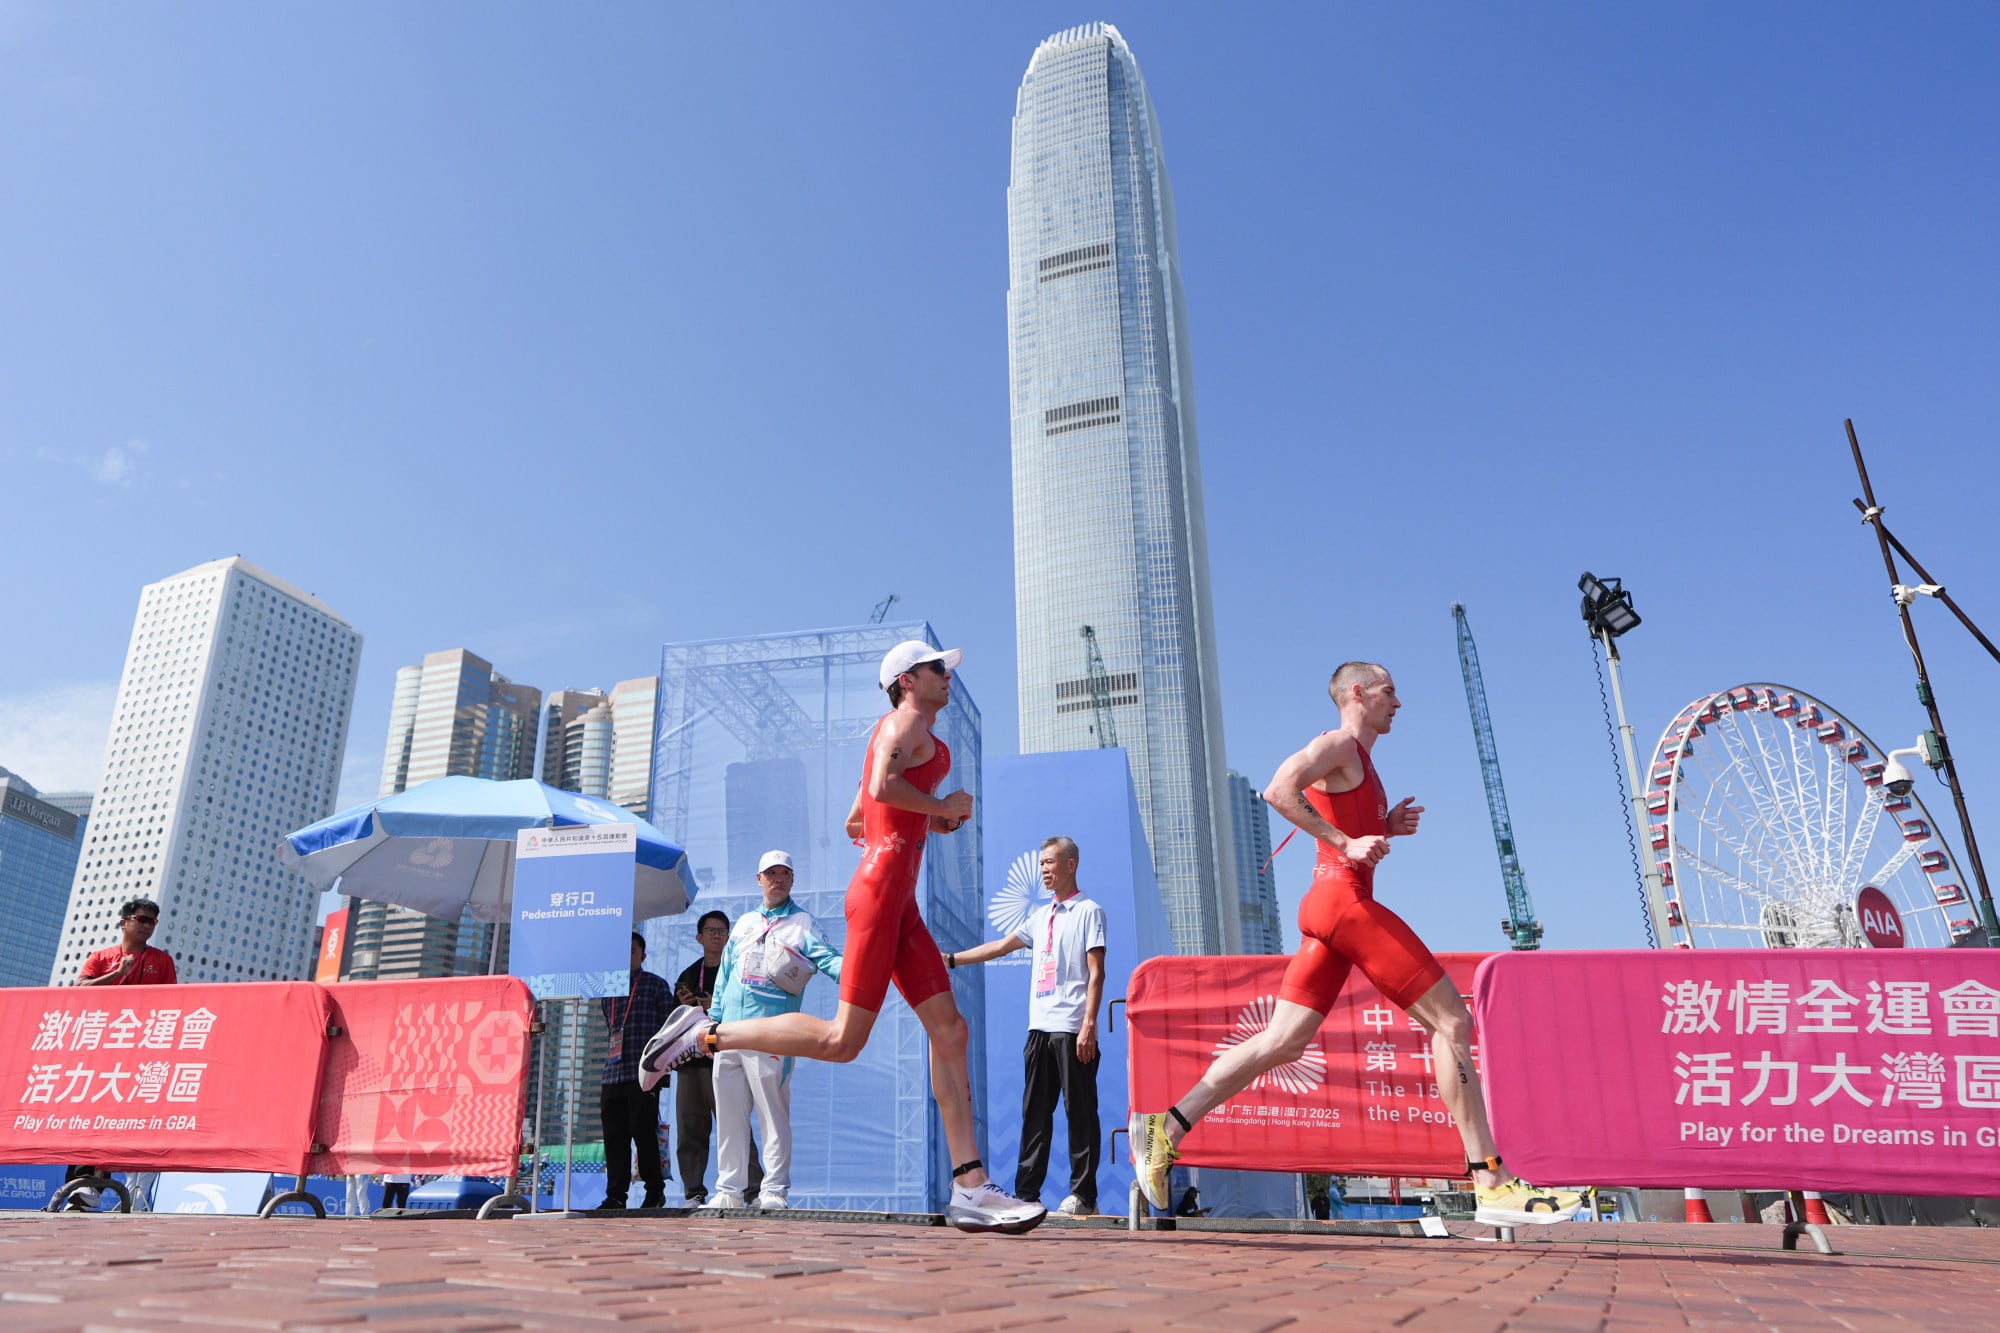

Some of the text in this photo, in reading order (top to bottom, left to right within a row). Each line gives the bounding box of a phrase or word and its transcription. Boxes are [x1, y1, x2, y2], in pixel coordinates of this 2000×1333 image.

[550, 892, 595, 907] 穿行口
[521, 905, 622, 920] Pedestrian Crossing
[1864, 908, 1901, 937] AIA
[1661, 980, 2000, 1037] 激情全運會
[31, 1007, 217, 1051] 激情全運會
[20, 1061, 208, 1104] 活力大灣區
[1366, 1080, 1440, 1099] The 15
[1673, 1050, 2000, 1109] 活力大灣區
[13, 1115, 197, 1133] Play for the Dreams in GBA
[1271, 1118, 1290, 1127] Hong
[1292, 1119, 1311, 1128] Kong
[1315, 1120, 1341, 1129] Macao
[1309, 1107, 1340, 1120] 2025
[1368, 1104, 1457, 1128] the Peop
[1145, 1114, 1156, 1165] ON RUNNING
[1680, 1121, 2000, 1147] Play for the Dreams in G
[0, 1178, 45, 1190] 汽集团
[11, 1190, 46, 1199] GROUP
